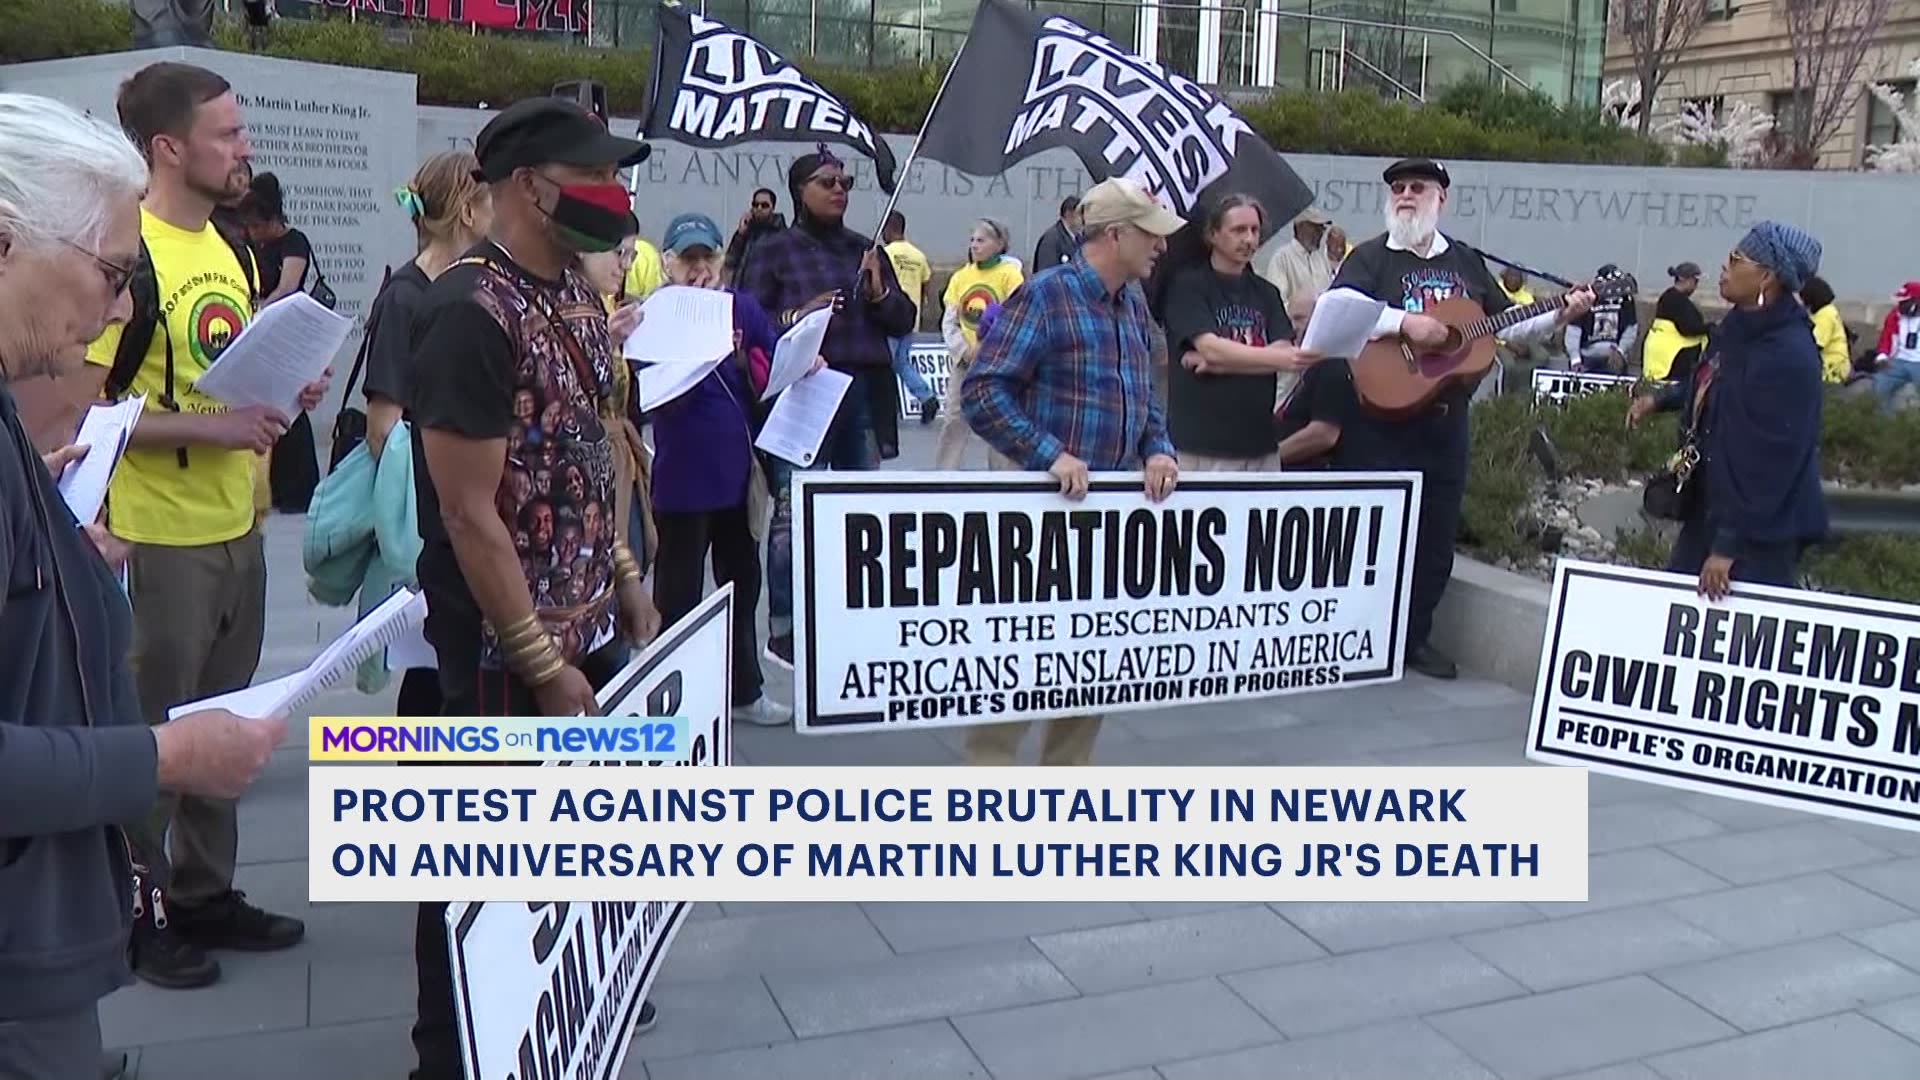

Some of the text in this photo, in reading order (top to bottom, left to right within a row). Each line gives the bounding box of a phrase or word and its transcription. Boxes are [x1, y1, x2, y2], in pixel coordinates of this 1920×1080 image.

[235, 94, 371, 119] Dr. Martin Luther King Jr.
[1036, 44, 1208, 194] LIVES
[248, 123, 360, 142] WE MUST LEARN TO LIVE
[304, 143, 352, 156] BROTHERS
[354, 144, 368, 157] OR
[273, 154, 322, 169] TOGETHER
[311, 202, 338, 213] DARK
[349, 187, 373, 199] THAT
[1454, 184, 1758, 229] EVERYWHERE
[337, 244, 363, 255] STICK
[346, 260, 365, 270] TOO
[845, 506, 1383, 609] REPARATIONS NOW!
[899, 598, 1339, 648] FOR THE DESCENDANTS OF
[839, 629, 1374, 699] AFRICANS ENSLAVED IN AMERICA
[888, 664, 1342, 723] PEOPLE'S ORGANIZATION FOR PROGRESS
[1559, 649, 1680, 716] CIVIL
[1691, 669, 1882, 749] RIGHTS
[1556, 718, 1920, 804] PEOPLE'S ORGANIZATION
